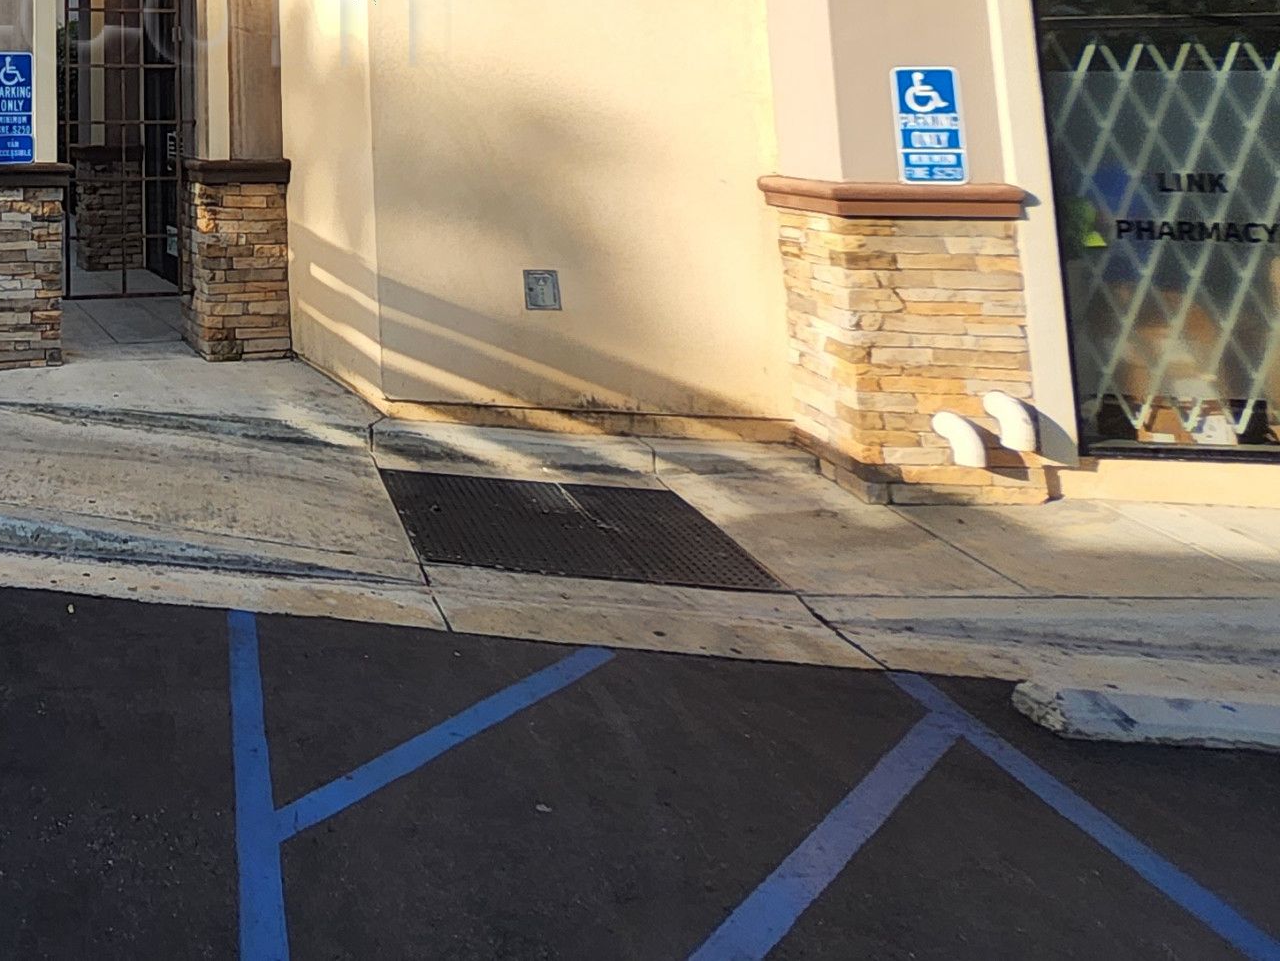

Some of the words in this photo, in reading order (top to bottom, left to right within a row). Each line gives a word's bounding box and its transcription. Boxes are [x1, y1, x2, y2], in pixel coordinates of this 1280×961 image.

[0, 99, 24, 112] ONLY
[11, 125, 31, 136] $250
[1156, 172, 1228, 194] LINK
[1116, 219, 1280, 244] PHARMACY
